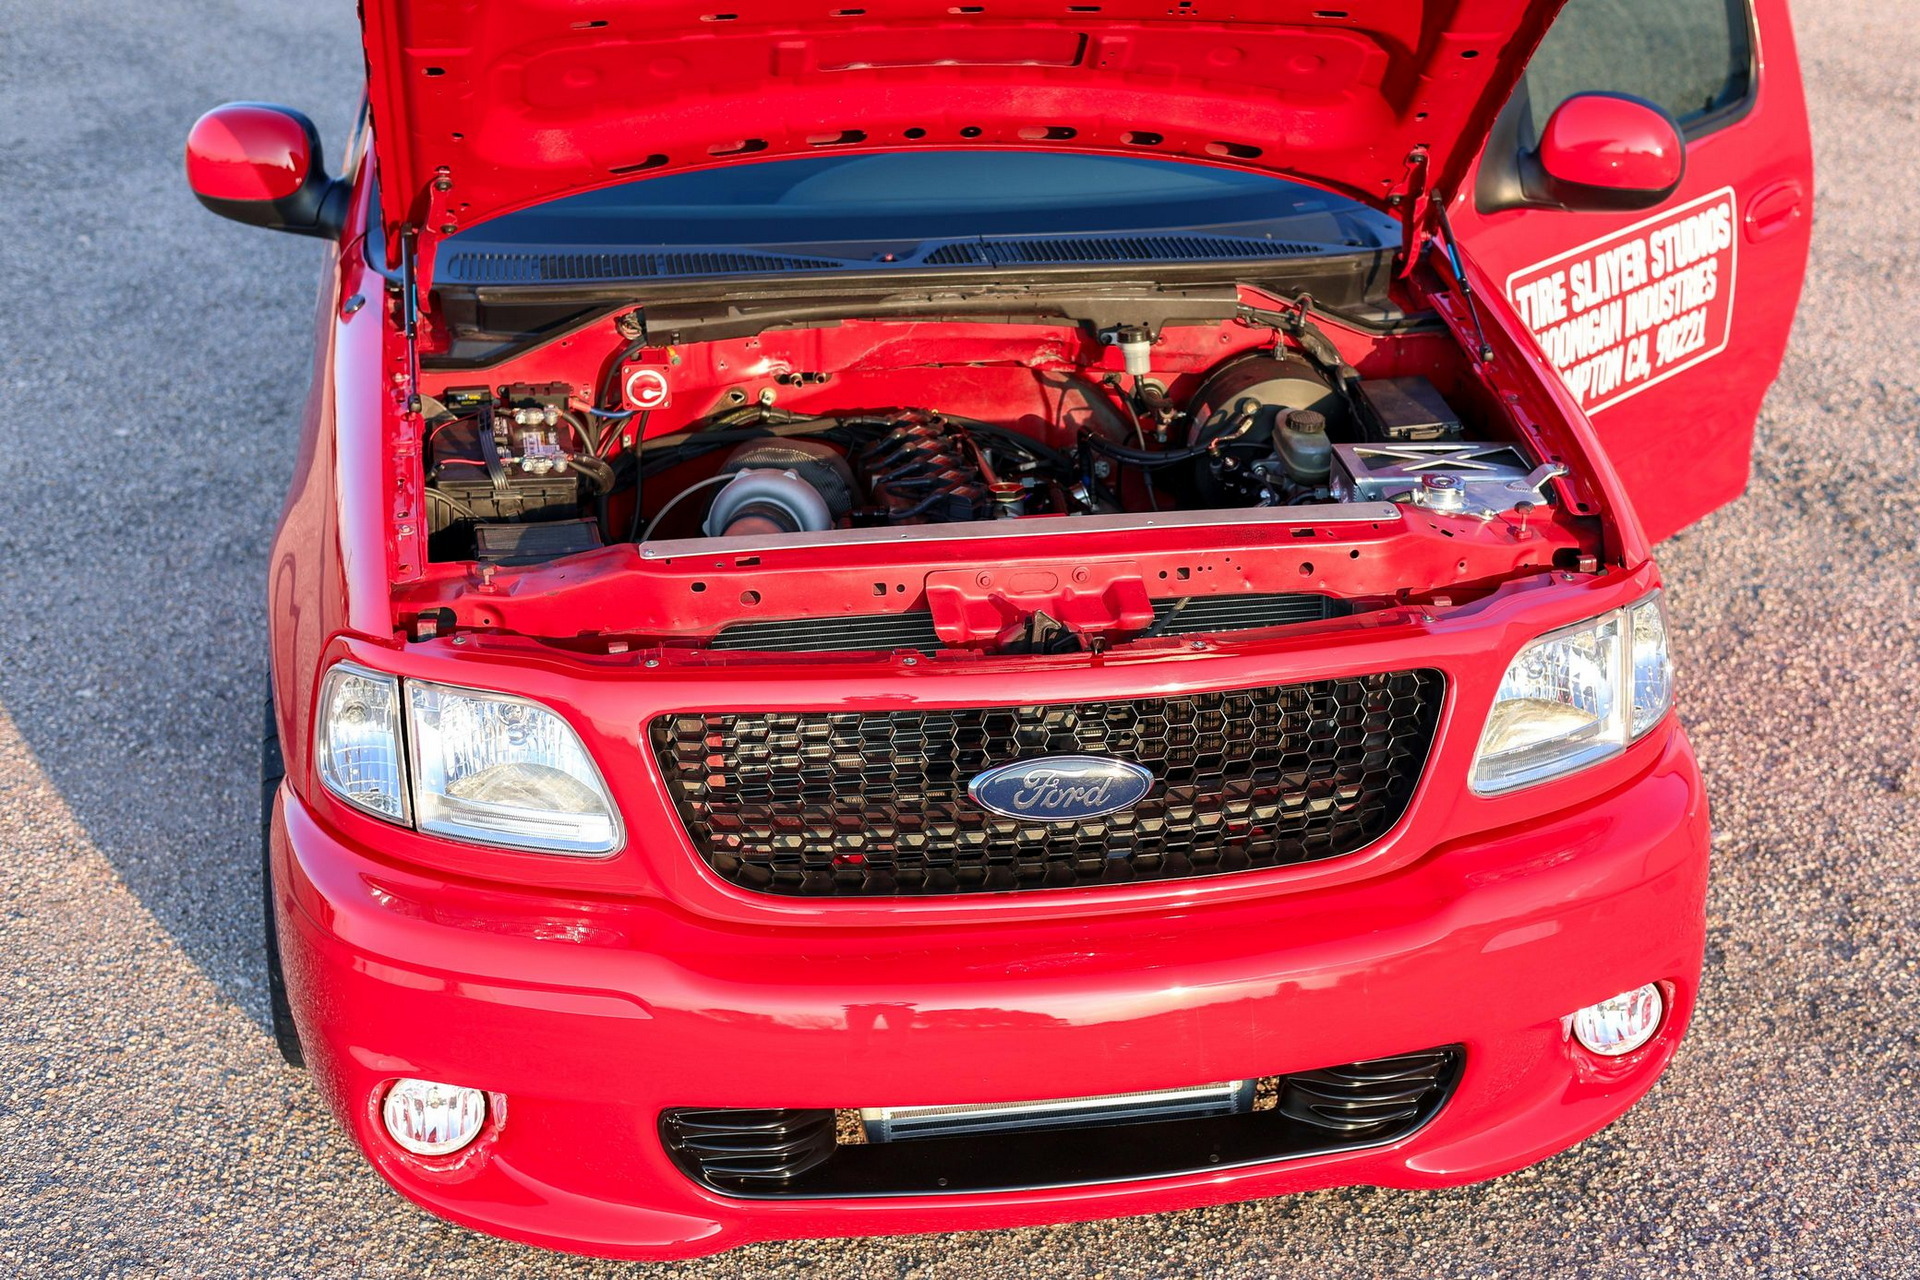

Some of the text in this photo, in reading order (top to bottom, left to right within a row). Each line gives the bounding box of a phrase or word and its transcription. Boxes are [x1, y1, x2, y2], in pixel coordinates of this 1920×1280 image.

[1515, 203, 1732, 331] TIRE SLAYER STUDIOS
[1625, 257, 1718, 338] INDUSTRIES
[1562, 306, 1707, 405] MPTON CA, 90221
[1013, 768, 1113, 810] Ford
